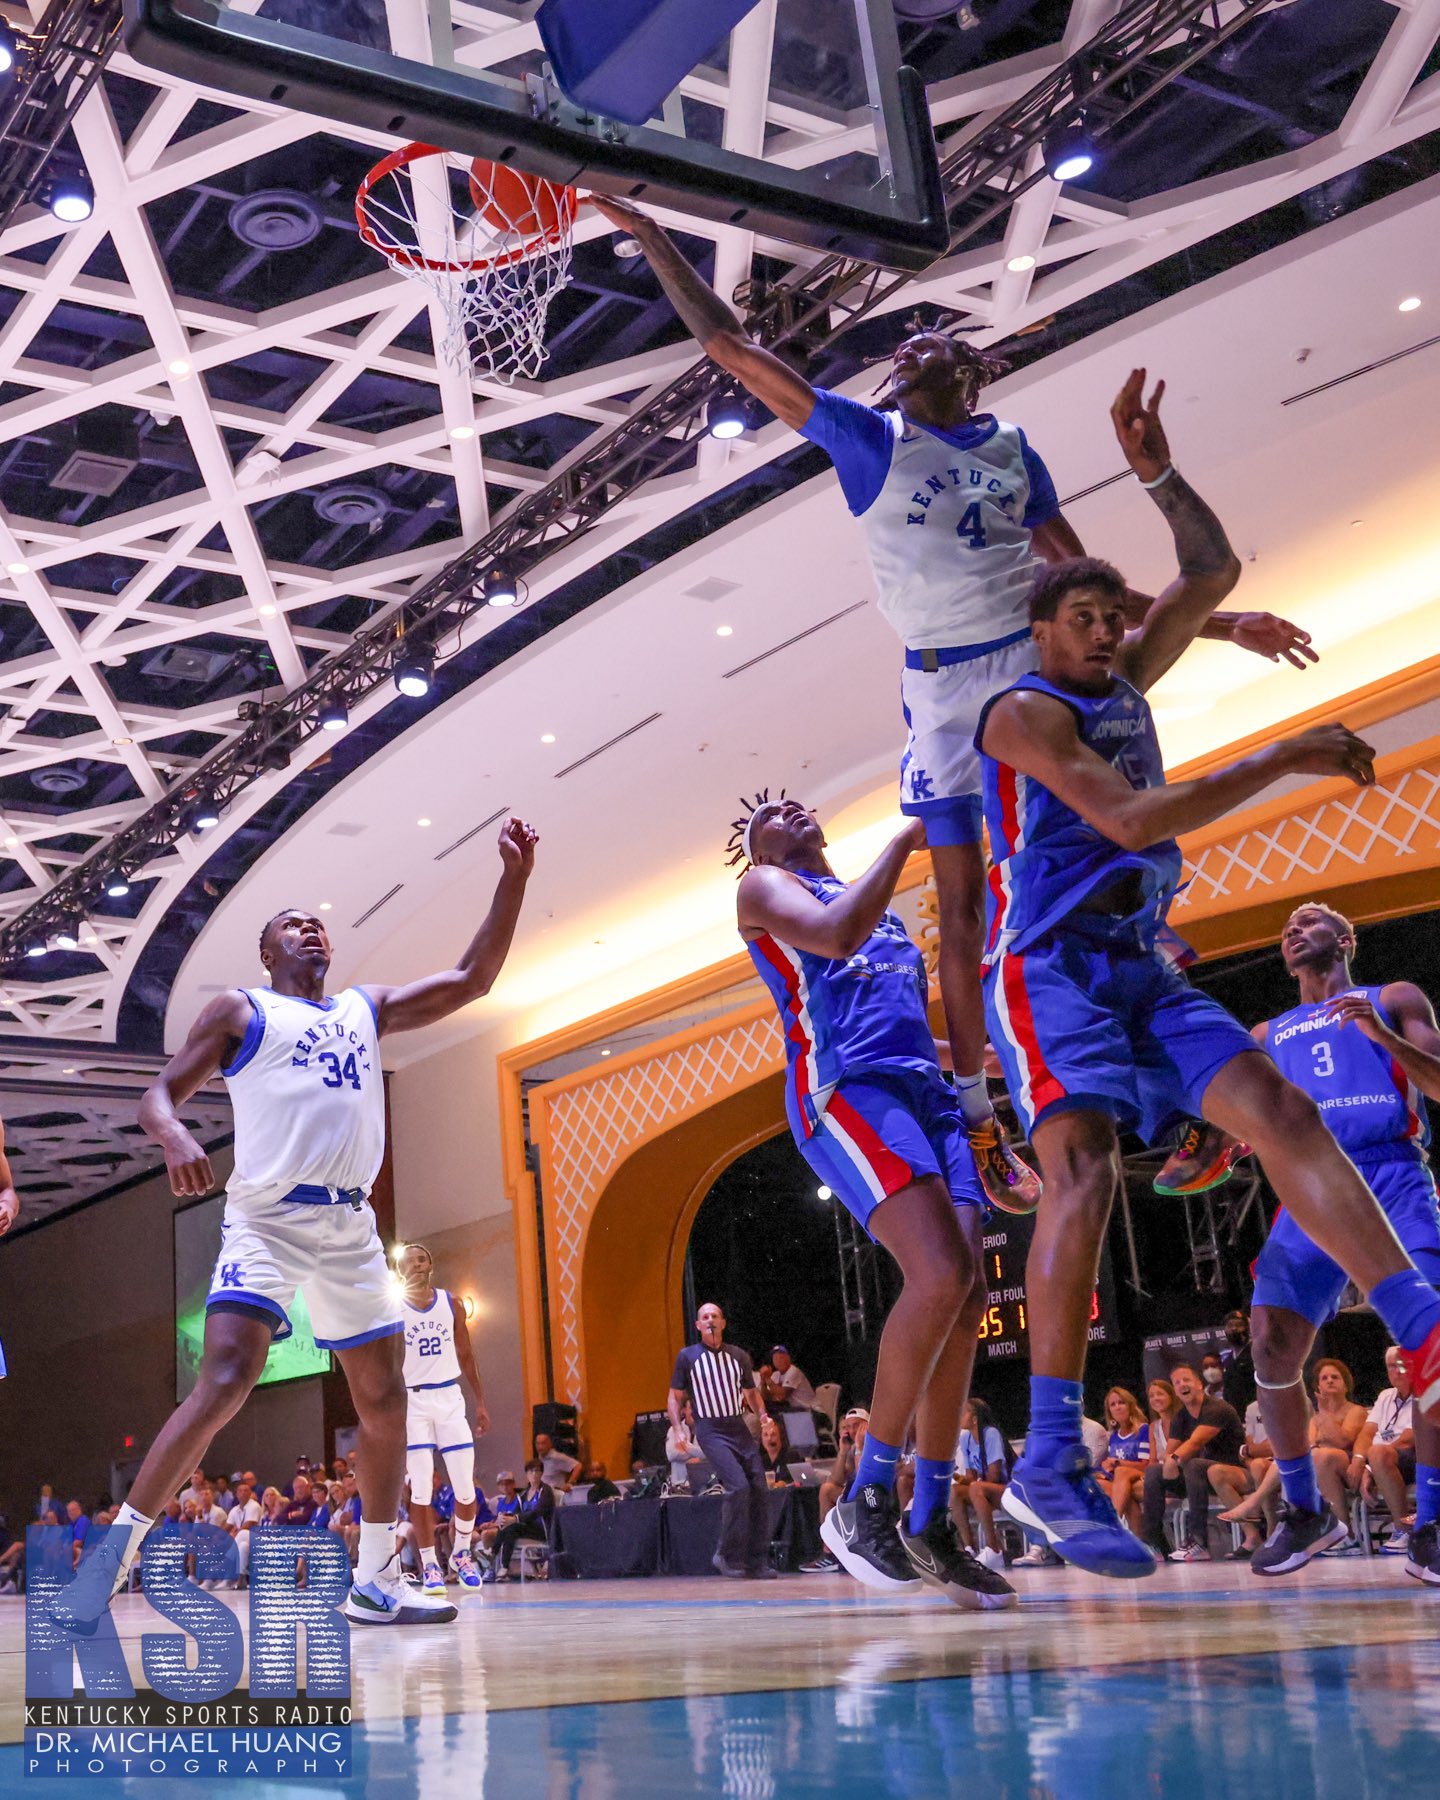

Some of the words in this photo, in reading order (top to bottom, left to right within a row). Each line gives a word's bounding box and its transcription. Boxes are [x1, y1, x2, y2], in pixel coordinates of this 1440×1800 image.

[956, 501, 986, 547] 4
[1274, 1009, 1346, 1047] DOMINICA
[292, 1023, 371, 1073] KENTUCKY
[1311, 1041, 1335, 1078] 3
[318, 1052, 361, 1091] 34
[1317, 1093, 1397, 1111] NRESERVAS
[982, 1232, 1008, 1249] ERIOD
[994, 1254, 1002, 1279] 1
[1003, 1286, 1026, 1302] FOUL
[405, 1321, 451, 1347] KENTUCKY
[418, 1336, 442, 1357] 22
[1088, 1326, 1106, 1342] ORE
[988, 1341, 1017, 1357] MATCH
